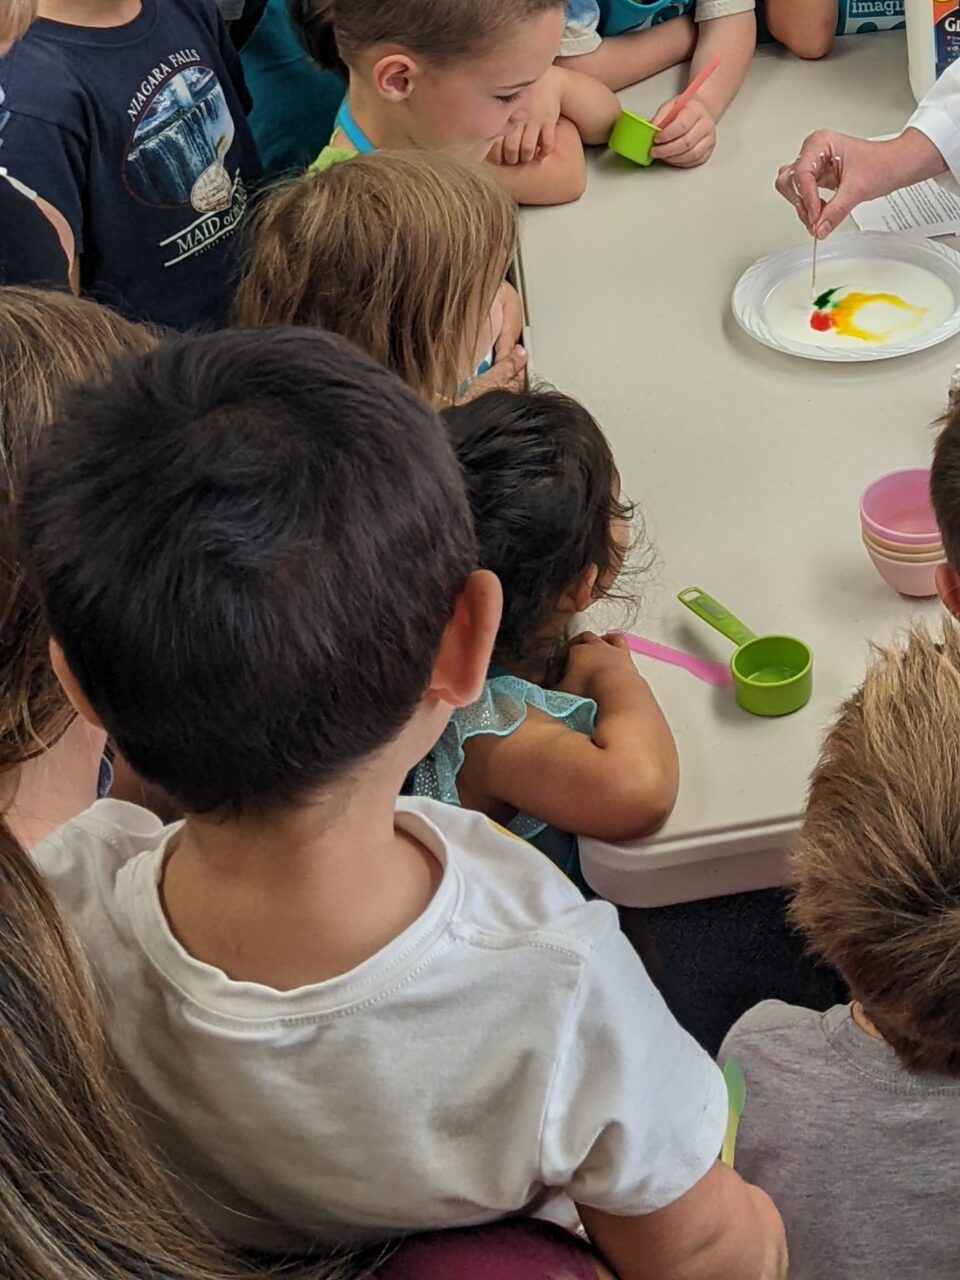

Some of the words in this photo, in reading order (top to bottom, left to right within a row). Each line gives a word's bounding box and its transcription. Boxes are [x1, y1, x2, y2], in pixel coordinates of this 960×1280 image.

[127, 62, 171, 122] NIAGARA
[170, 49, 201, 68] FALLS
[176, 216, 220, 254] MAID
